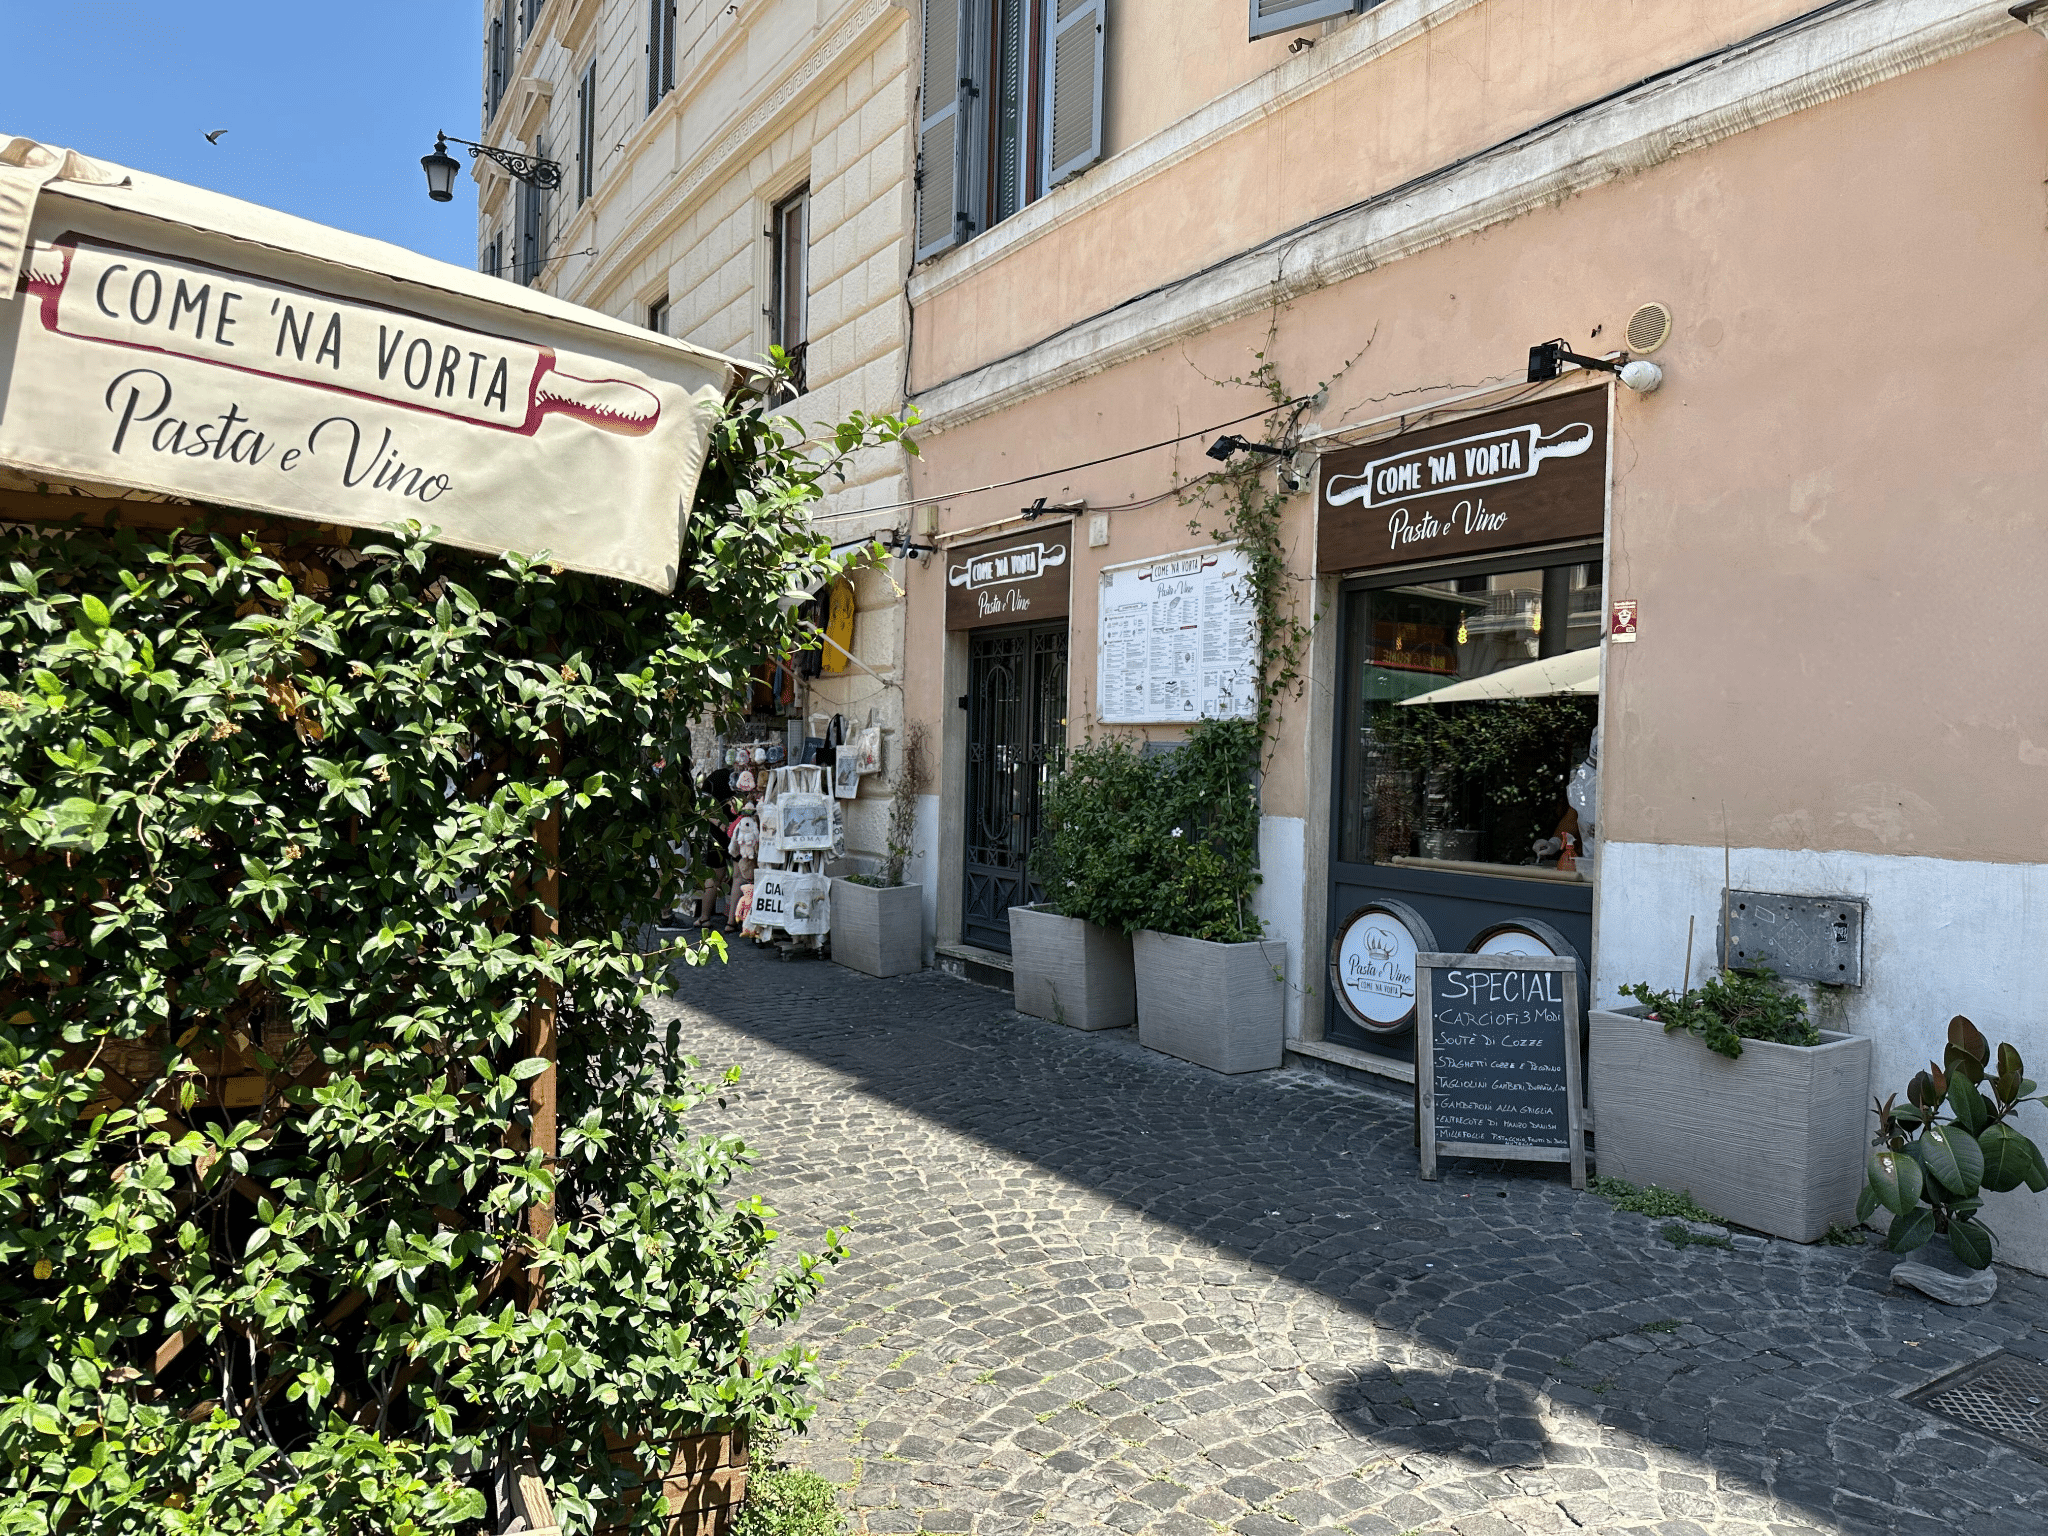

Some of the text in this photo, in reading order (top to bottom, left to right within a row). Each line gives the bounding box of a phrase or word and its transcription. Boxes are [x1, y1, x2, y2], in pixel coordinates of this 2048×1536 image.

[96, 263, 510, 413] COME 'NA VORTA
[105, 367, 454, 503] Pasta e Vino
[1376, 439, 1522, 496] COME 'NA VORTA
[1388, 499, 1508, 550] Pasta e Vino
[972, 561, 994, 582] COME
[1011, 551, 1037, 574] VORTA
[1155, 564, 1169, 577] COME
[1181, 558, 1198, 572] VORTA
[978, 590, 1001, 618] Pasta
[1006, 588, 1031, 612] Vino
[765, 882, 784, 896] CIA
[1349, 953, 1376, 975] Pasta
[1383, 961, 1411, 984] Vino
[1441, 970, 1562, 1006] SPECIAL
[1519, 1010, 1531, 1024] 3
[1501, 1035, 1544, 1047] COZZE
[1436, 1056, 1488, 1069] SPAGHETTI
[1440, 1098, 1493, 1111] GAMBERONI
